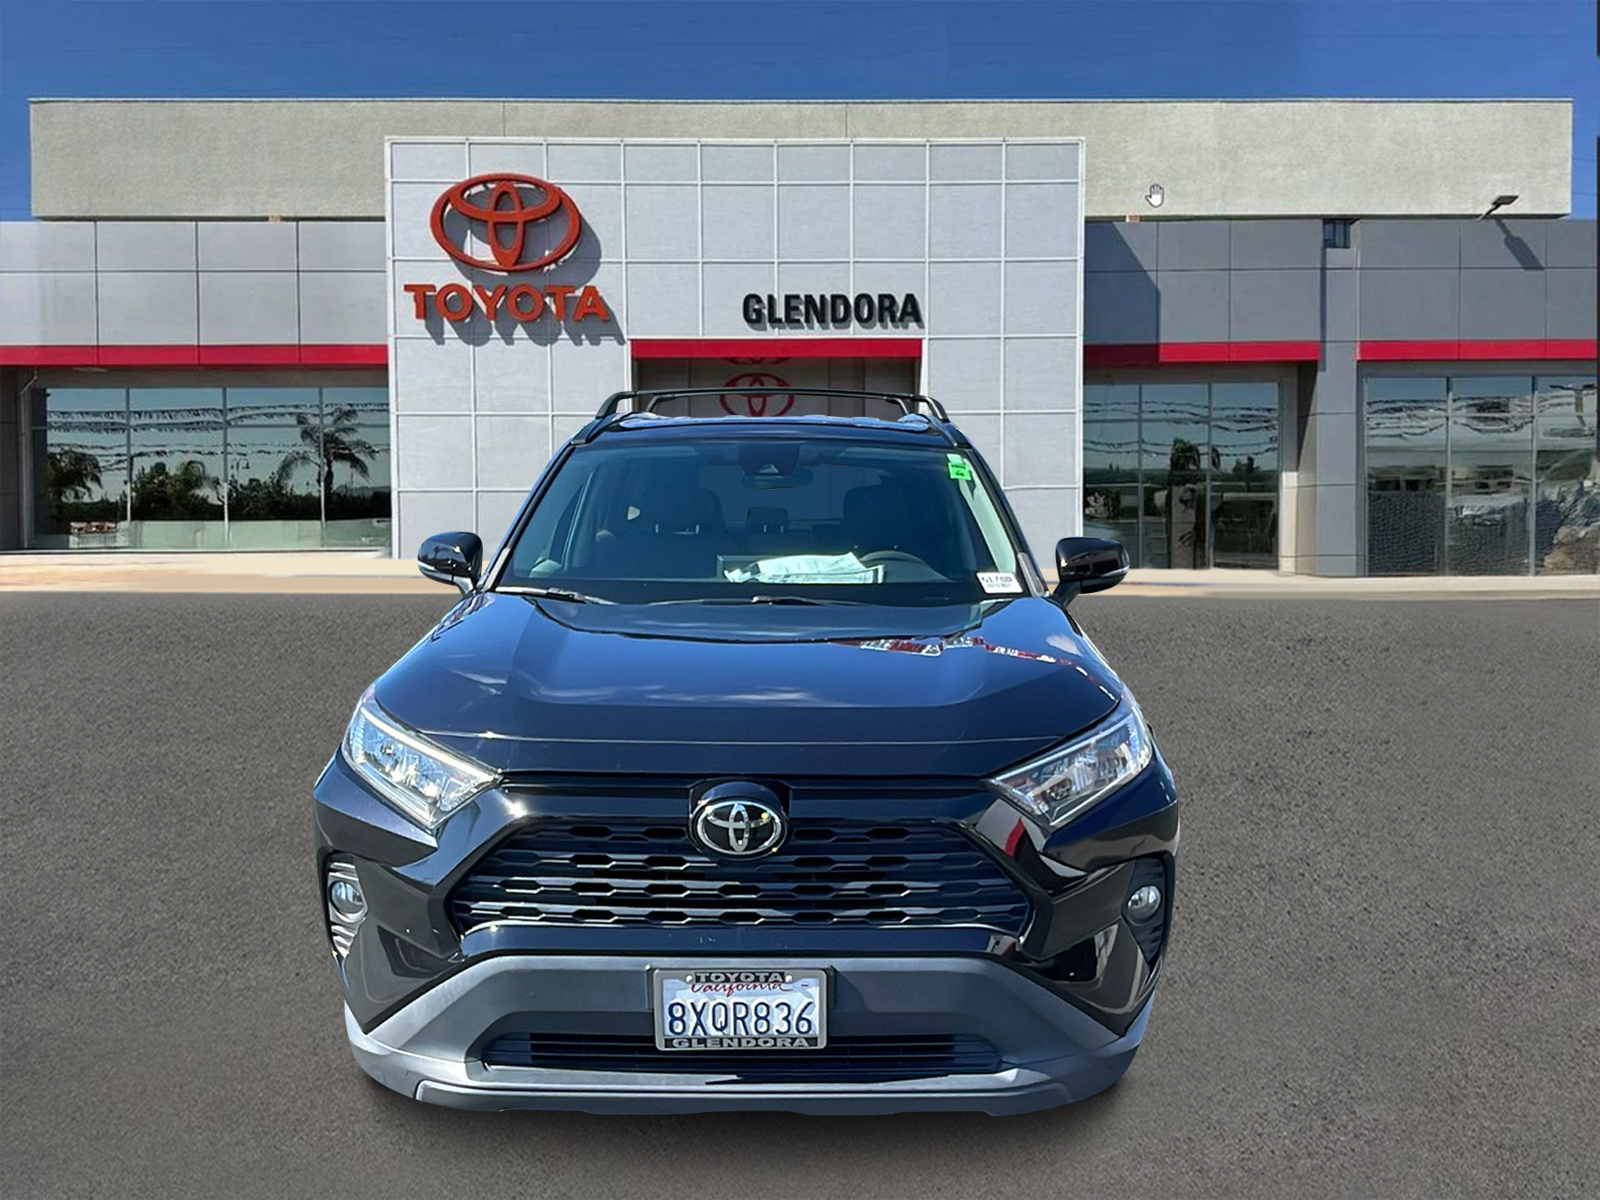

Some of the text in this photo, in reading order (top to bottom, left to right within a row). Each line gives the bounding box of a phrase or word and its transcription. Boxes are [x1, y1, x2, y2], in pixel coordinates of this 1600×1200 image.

[404, 283, 609, 322] TOYOTA
[742, 293, 922, 325] GLENDORA
[696, 972, 783, 982] TOYOTA
[668, 1001, 813, 1036] 8XQR836
[672, 1037, 809, 1048] GLENDORA
